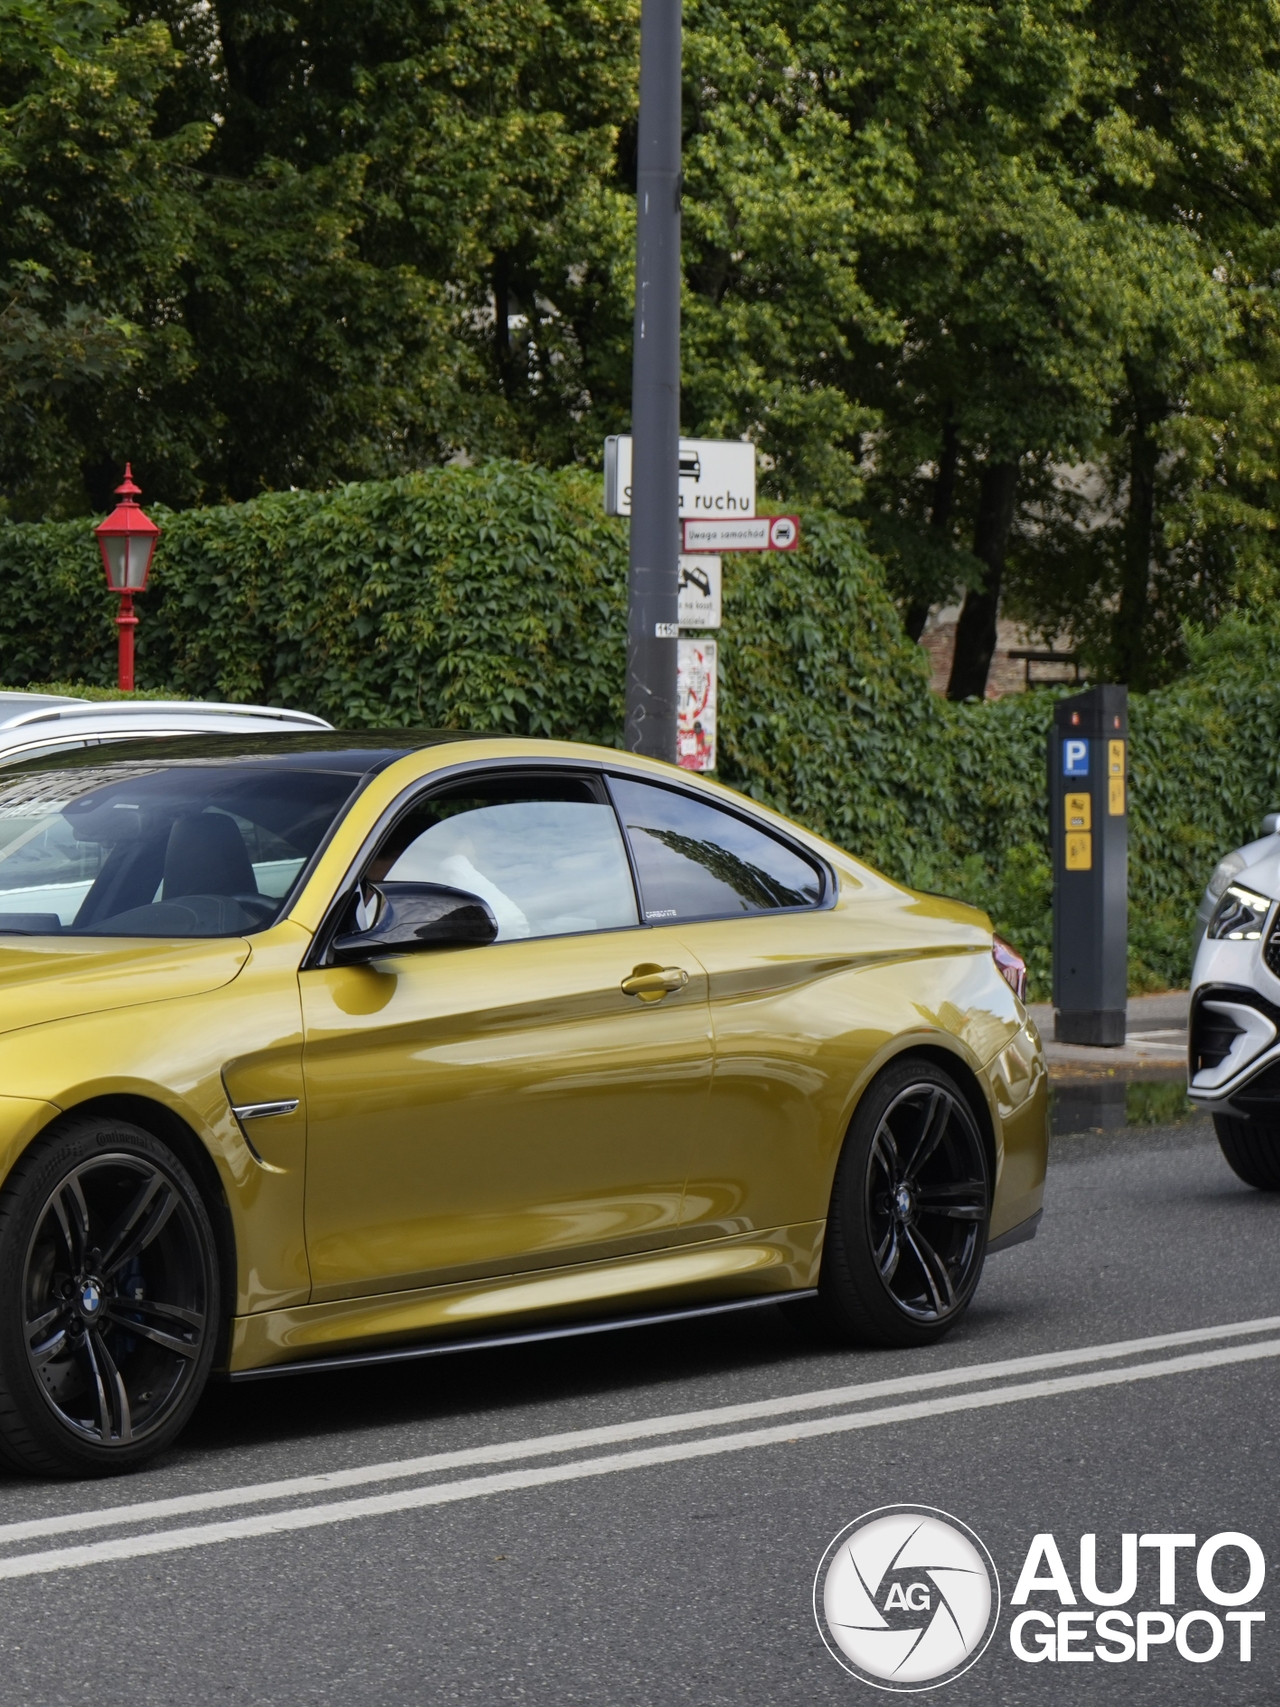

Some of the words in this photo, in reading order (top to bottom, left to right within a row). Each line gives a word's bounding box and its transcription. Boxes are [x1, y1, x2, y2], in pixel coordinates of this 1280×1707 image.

[695, 490, 750, 511] ruchu
[688, 530, 717, 542] Uwaga
[1066, 740, 1087, 770] P
[95, 1129, 149, 1150] Continental
